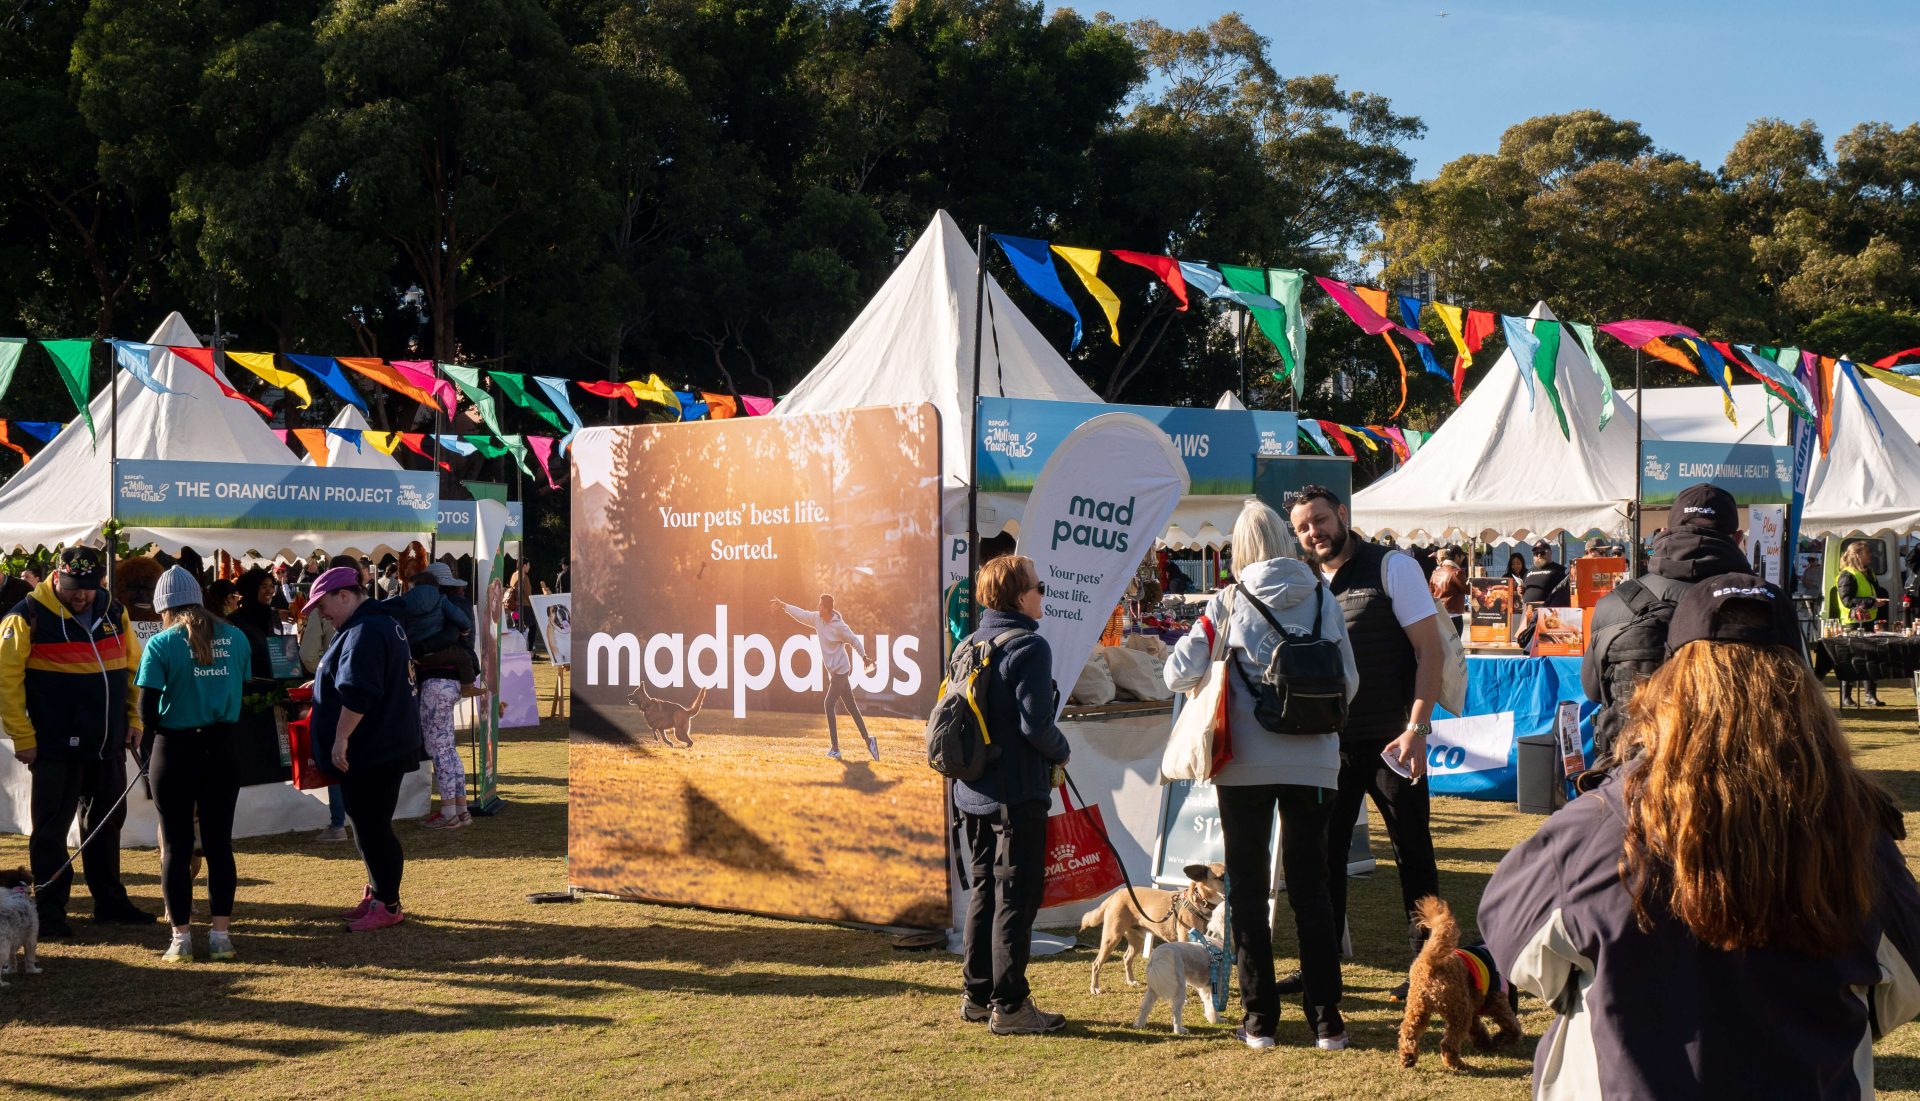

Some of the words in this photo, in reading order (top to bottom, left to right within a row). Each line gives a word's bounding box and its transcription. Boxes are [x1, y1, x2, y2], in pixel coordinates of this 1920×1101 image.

[988, 428, 1019, 441] Million
[984, 436, 1006, 451] Paws
[1006, 441, 1028, 457] Walk
[1679, 463, 1713, 477] ELANCO
[1714, 464, 1743, 478] ANIMAL
[1743, 464, 1769, 478] HEALTH
[120, 486, 142, 499] Paws
[141, 490, 164, 502] Walk
[124, 480, 154, 491] Million
[175, 481, 210, 498] THE
[215, 482, 320, 501] ORANGUTAN
[325, 486, 393, 503] PROJECT
[437, 511, 470, 524] OTOS
[659, 506, 701, 528] Your
[750, 502, 791, 525] best
[794, 499, 830, 524] life.
[1068, 495, 1136, 527] mad
[1762, 516, 1777, 538] Play
[1050, 519, 1129, 553] paws
[710, 536, 778, 561] Sorted.
[1049, 564, 1076, 579] Your
[1046, 584, 1070, 600] best
[1071, 589, 1092, 604] life.
[1713, 587, 1761, 598] RSPCA
[1044, 604, 1083, 621] Sorted.
[137, 621, 158, 631] Give
[212, 648, 231, 658] life.
[587, 604, 922, 719] madpaws
[193, 665, 230, 677] Sorted.
[1044, 862, 1068, 877] YAL
[1068, 852, 1100, 870] CANIN
